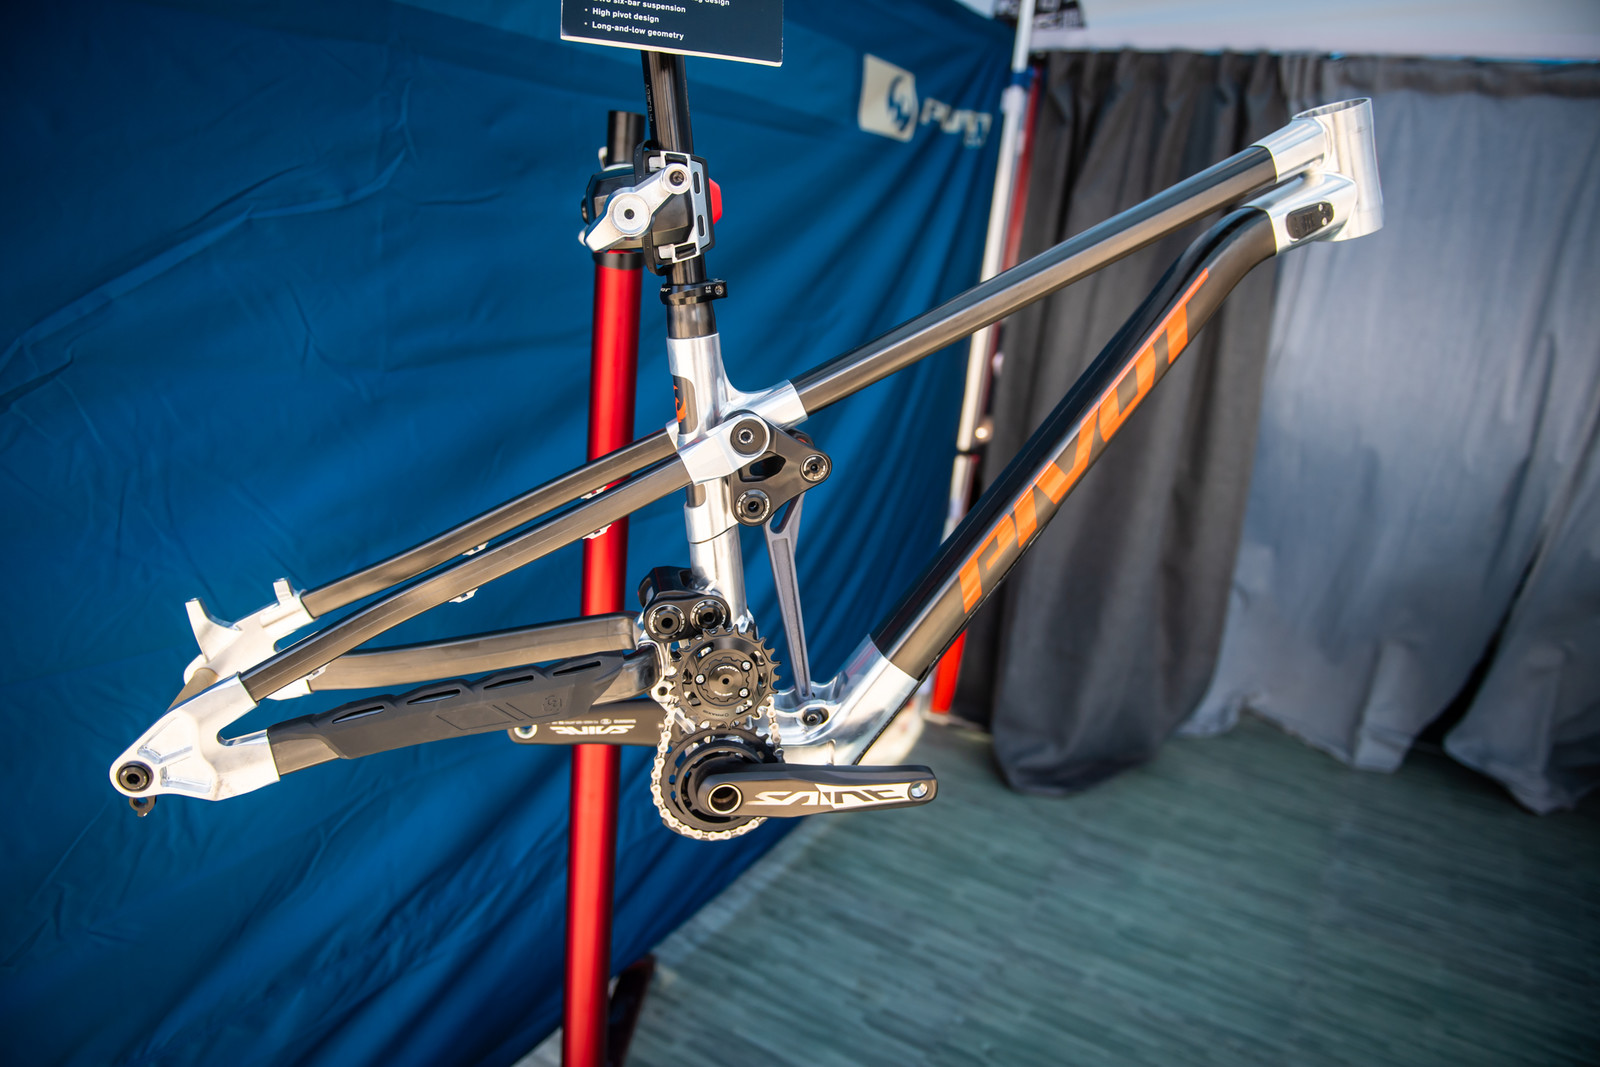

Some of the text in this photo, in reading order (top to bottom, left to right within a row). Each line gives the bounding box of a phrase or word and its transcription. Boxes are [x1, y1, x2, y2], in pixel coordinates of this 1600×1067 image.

[592, 7, 660, 24] High pivot design
[642, 2, 686, 13] suspension
[592, 21, 684, 40] Long-and-low geometry
[958, 267, 1209, 614] PIVOT
